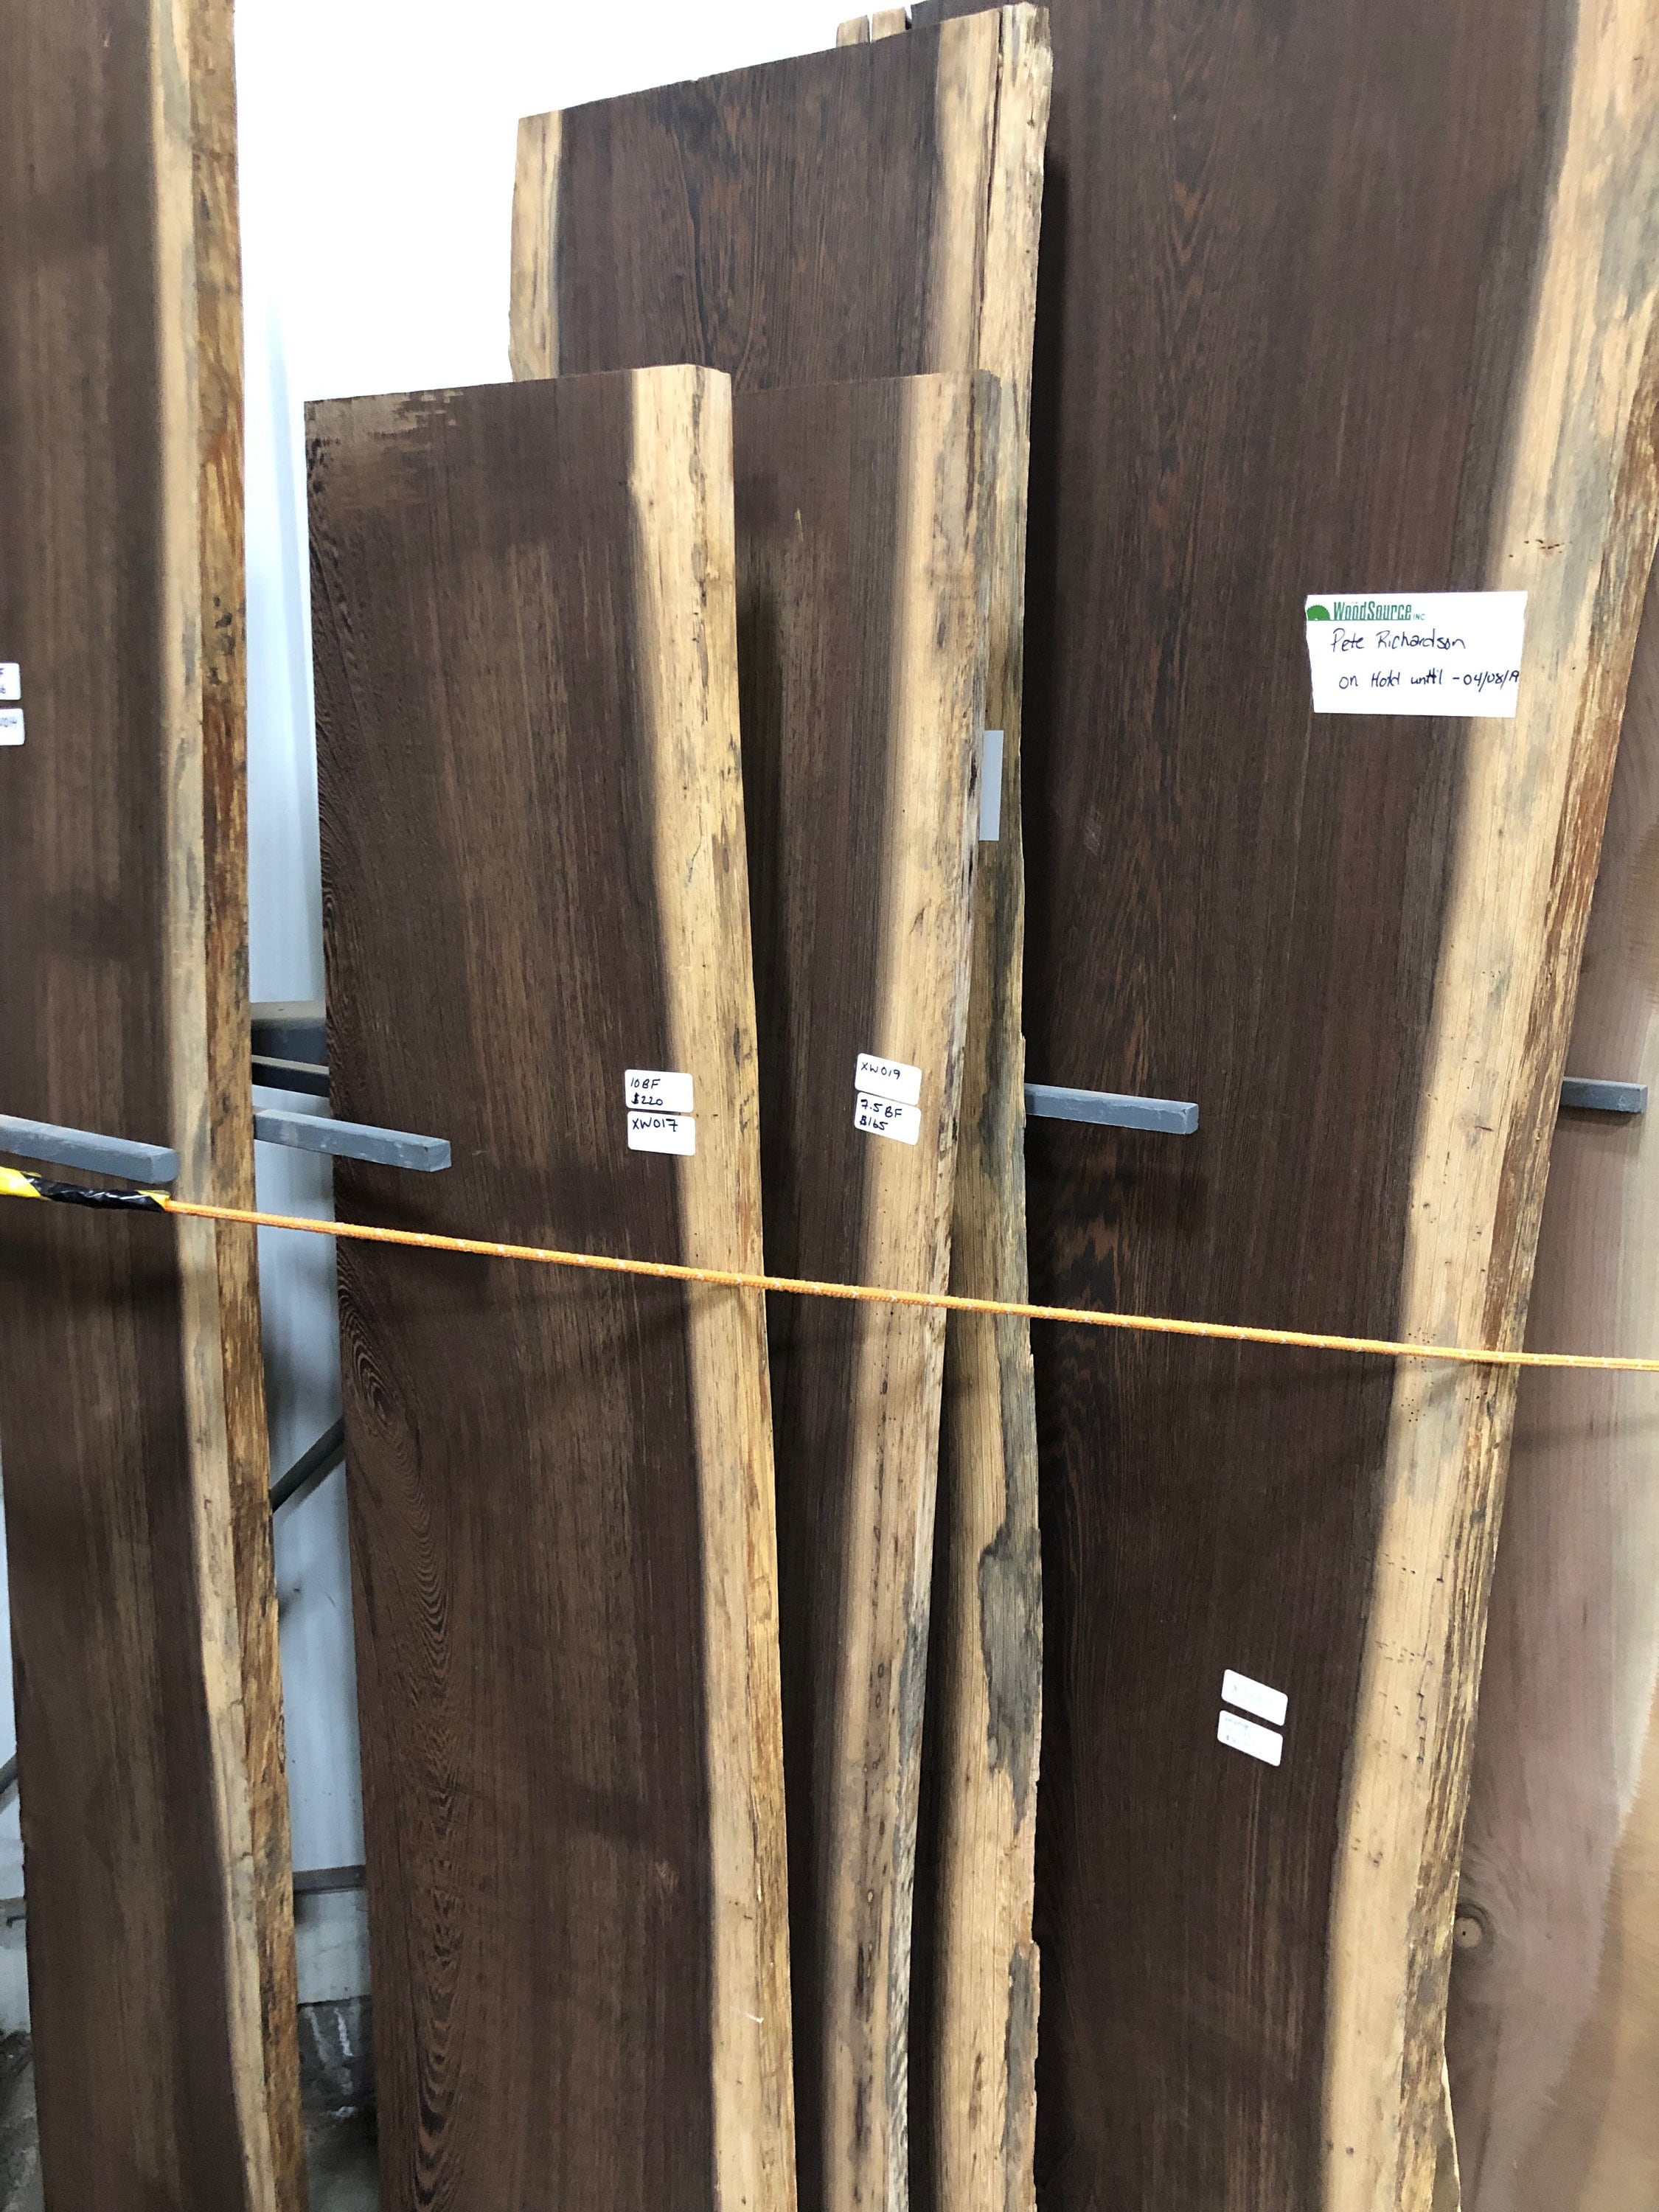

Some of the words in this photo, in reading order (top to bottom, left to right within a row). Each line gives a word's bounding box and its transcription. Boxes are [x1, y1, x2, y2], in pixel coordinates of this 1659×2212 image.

[1334, 601, 1412, 620] WoodSource
[1331, 627, 1364, 652] Pete
[1376, 628, 1465, 650] Richardson
[631, 1092, 664, 1106] $220
[632, 1116, 678, 1133] XW017
